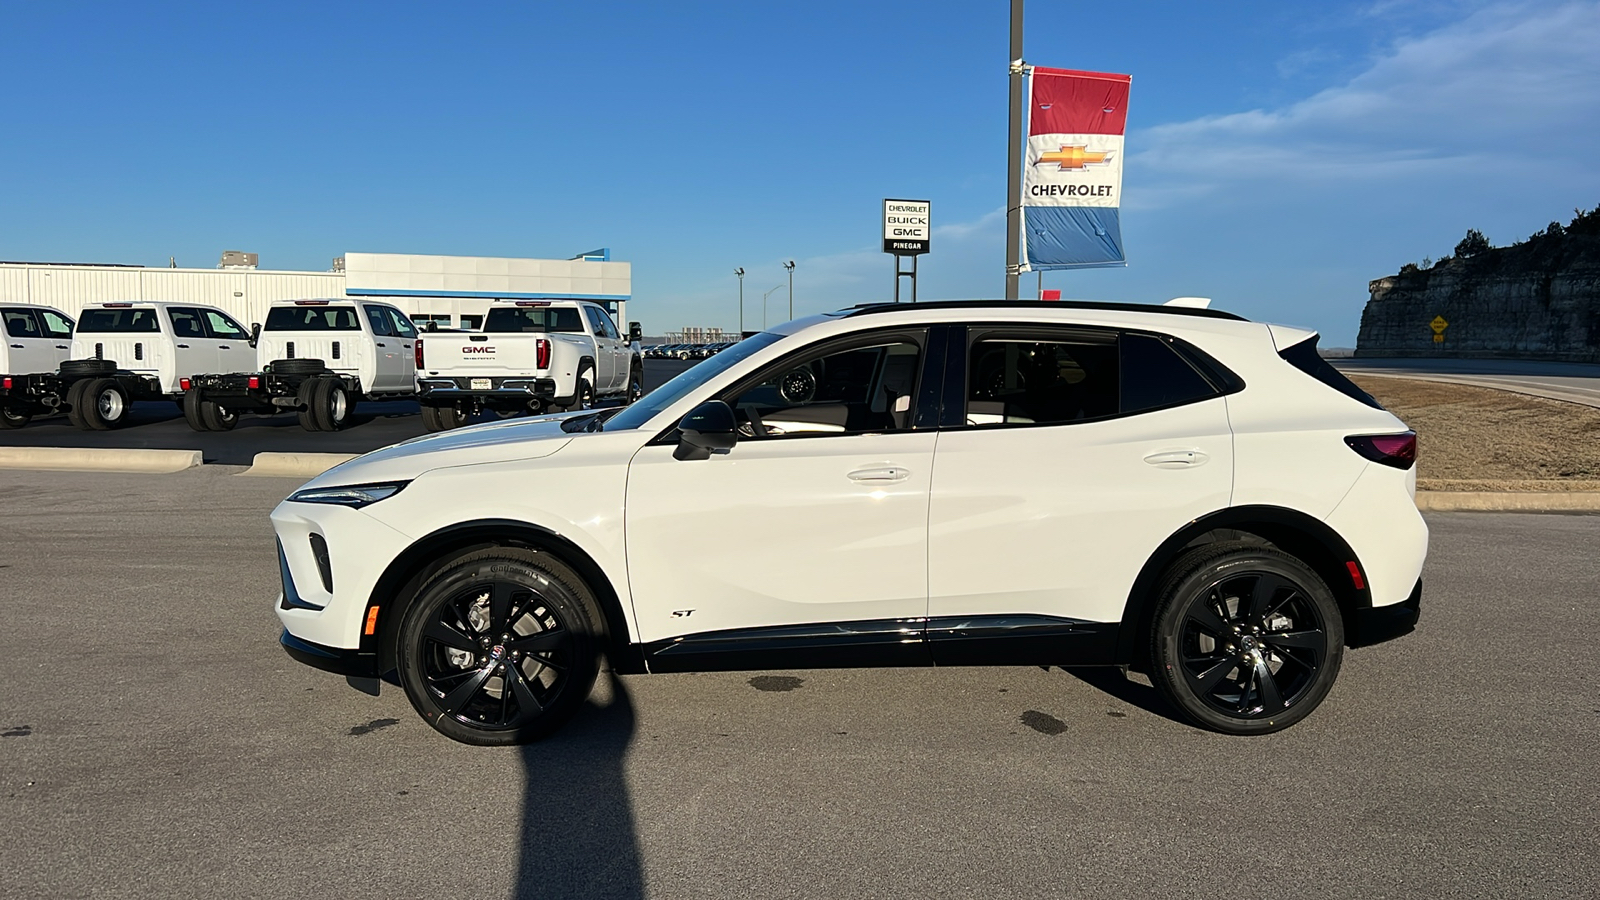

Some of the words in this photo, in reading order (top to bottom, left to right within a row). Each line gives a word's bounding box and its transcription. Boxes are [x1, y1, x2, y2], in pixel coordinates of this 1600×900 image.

[1031, 184, 1112, 196] CHEVROLET
[888, 205, 927, 213] CHEVROLET
[888, 217, 927, 225] BUICK
[462, 346, 496, 354] GMC
[670, 609, 696, 618] ST
